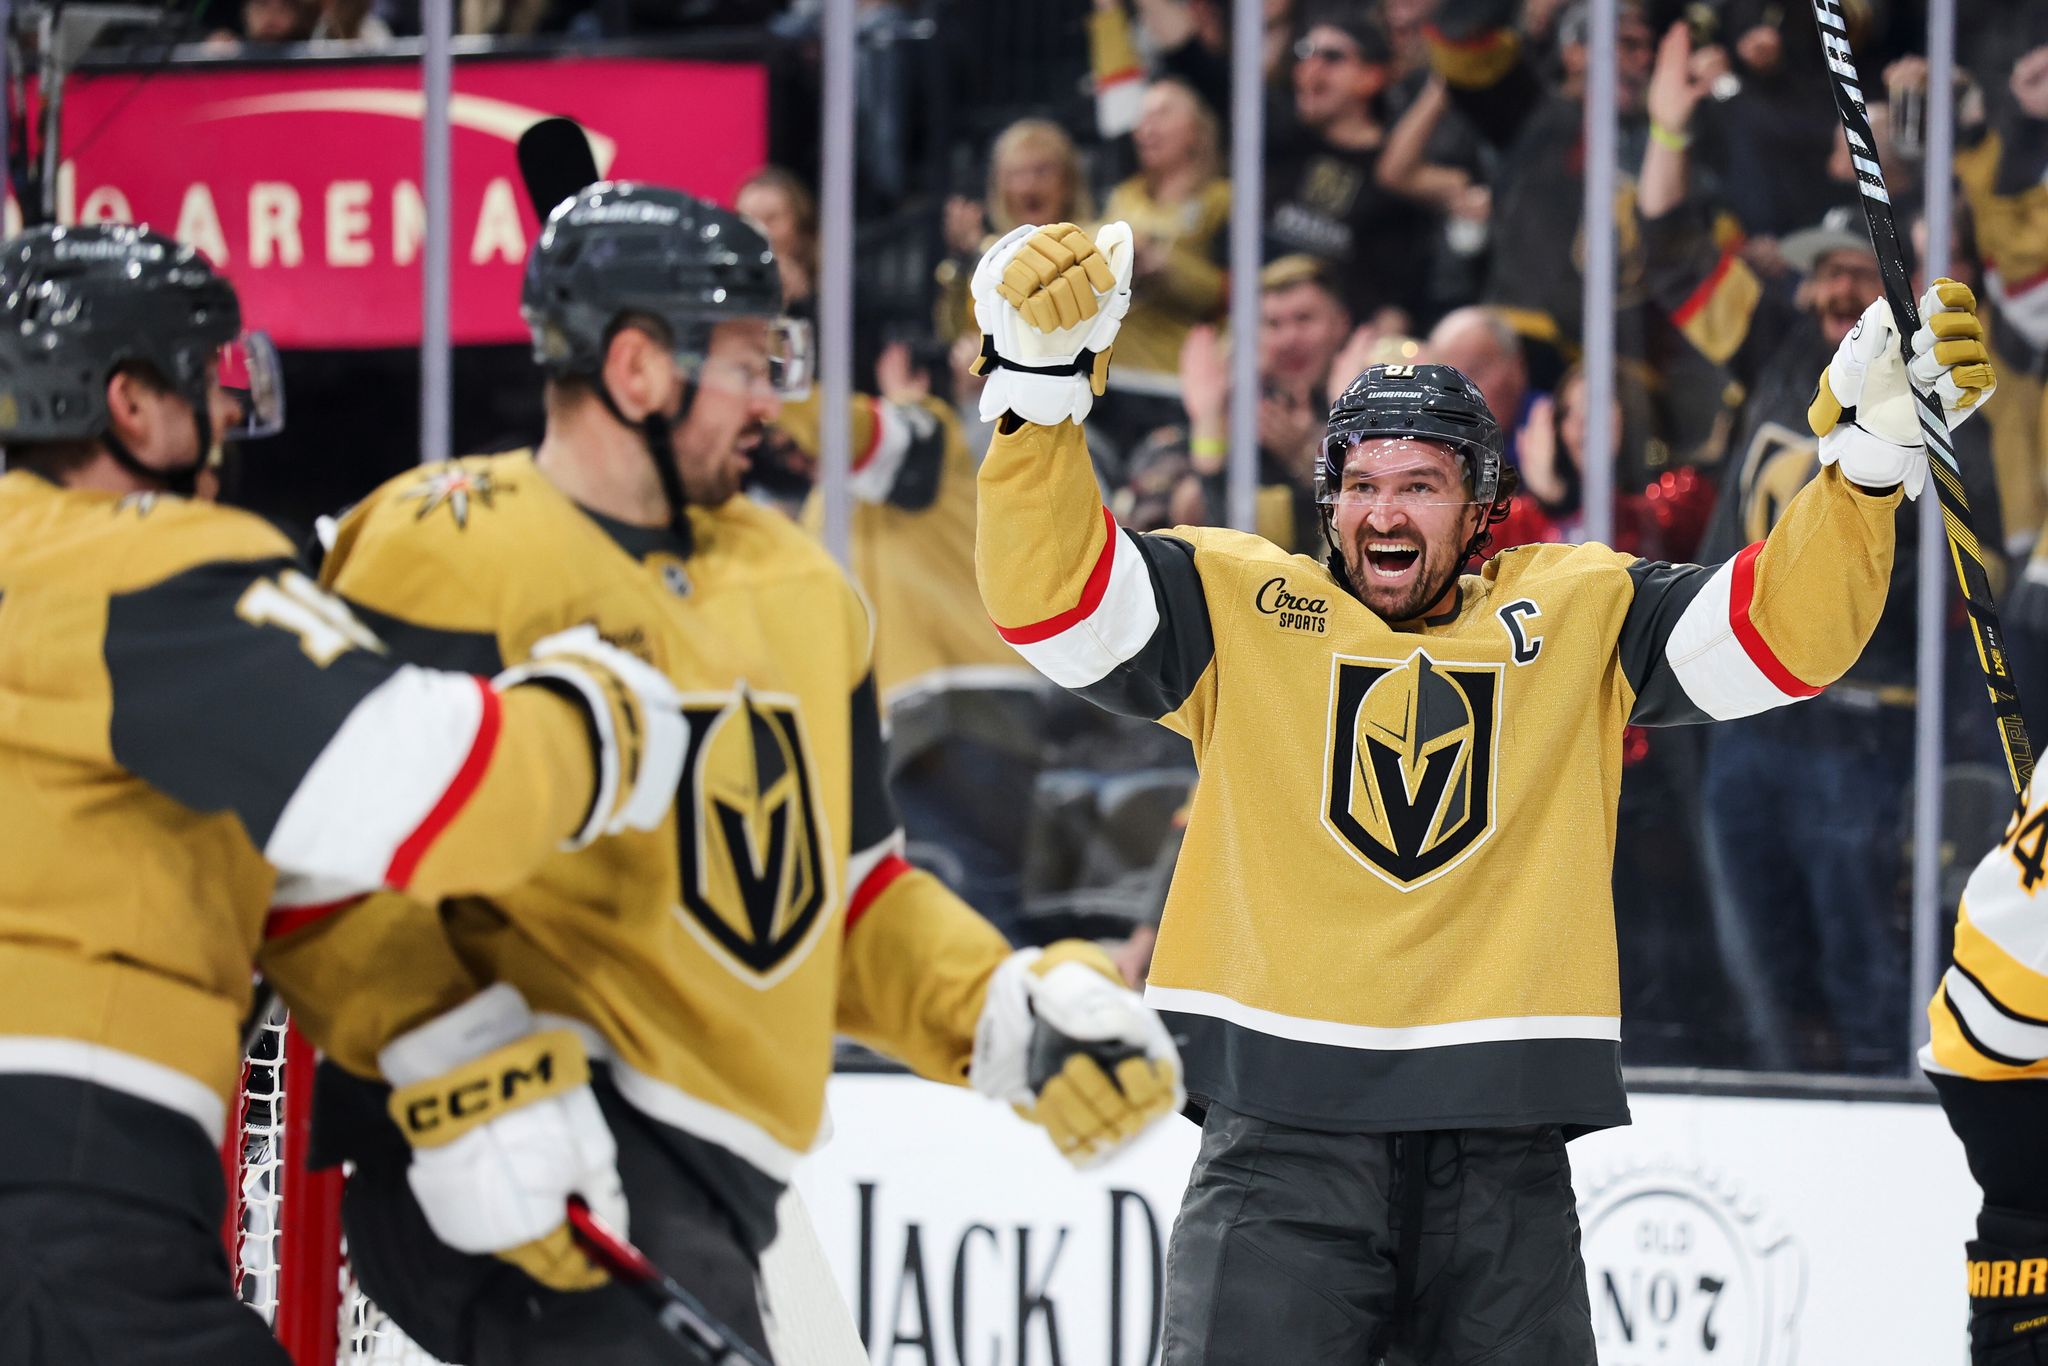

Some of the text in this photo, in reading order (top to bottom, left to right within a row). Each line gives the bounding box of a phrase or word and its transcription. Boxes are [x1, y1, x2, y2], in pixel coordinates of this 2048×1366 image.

[174, 176, 527, 269] ARENA
[1367, 391, 1423, 399] WARRIOR
[1256, 577, 1329, 614] Circa
[1279, 612, 1326, 633] SPORTS
[1495, 597, 1544, 667] C
[1986, 625, 1997, 647] PRO
[406, 1052, 553, 1133] CCM
[1635, 1217, 1697, 1254] OLD
[856, 1182, 1069, 1366] JACK
[1696, 1276, 1727, 1352] 7
